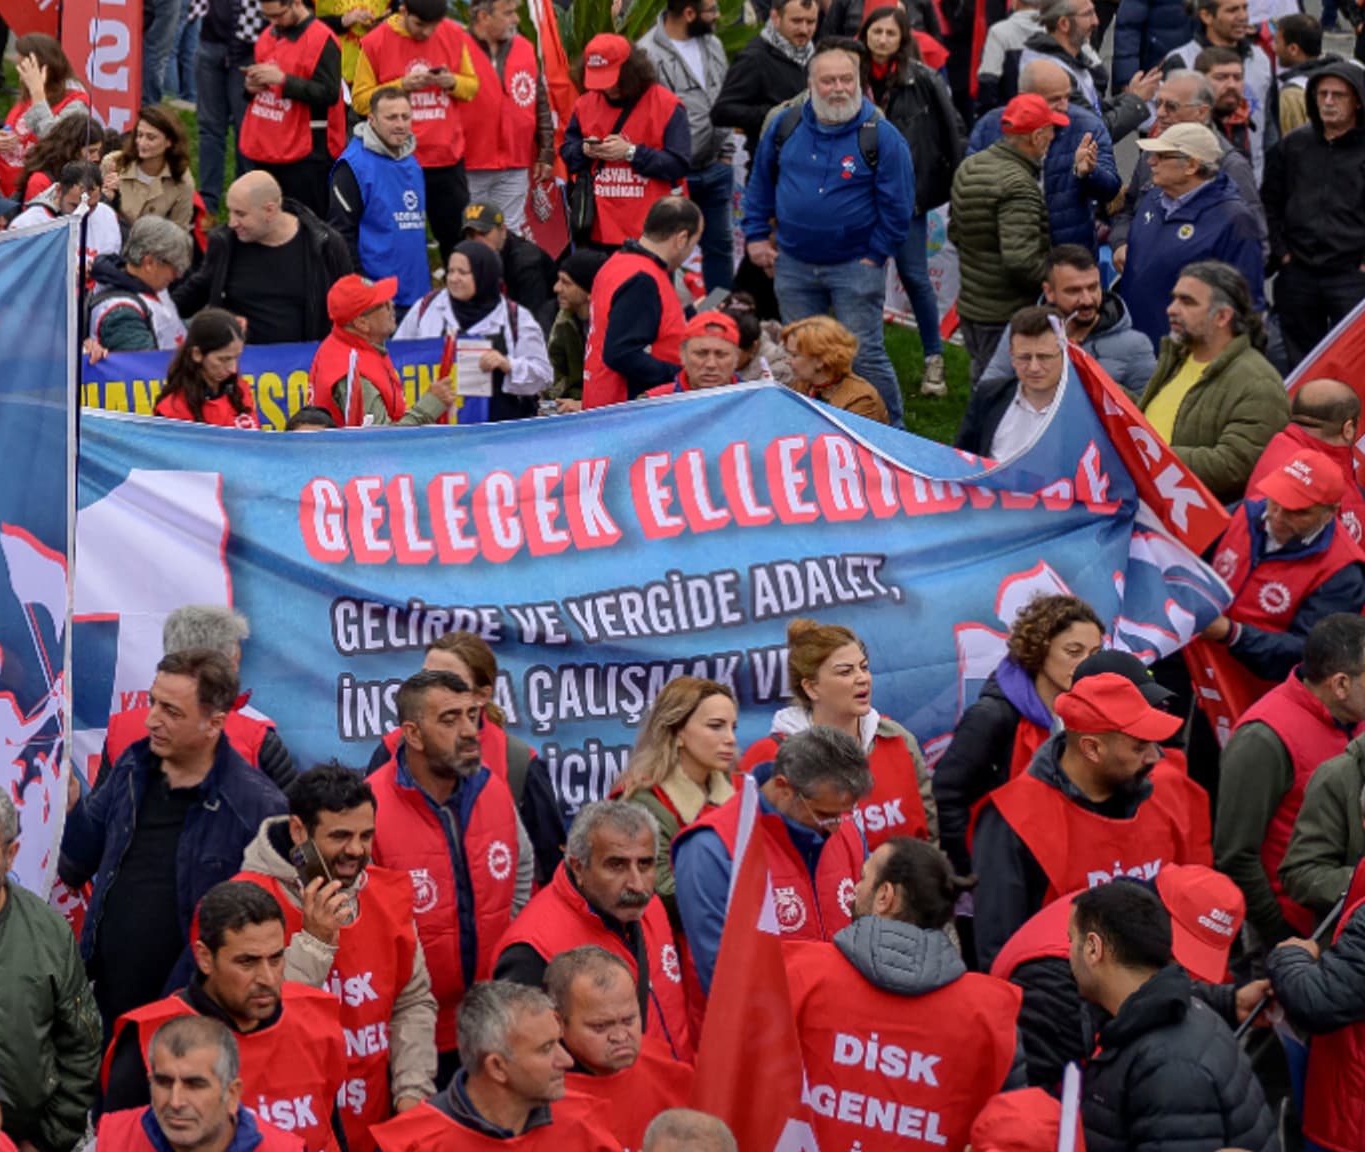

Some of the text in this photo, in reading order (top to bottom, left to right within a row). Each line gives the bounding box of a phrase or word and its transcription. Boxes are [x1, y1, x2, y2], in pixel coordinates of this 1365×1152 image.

[300, 456, 622, 566] GELECEK
[333, 553, 903, 653] GELİRDE VE VERGİDE ADALET,
[853, 797, 907, 833] İSK
[344, 1020, 389, 1058] NEL
[832, 1032, 942, 1087] DİSK
[810, 1083, 948, 1145] GENEL
